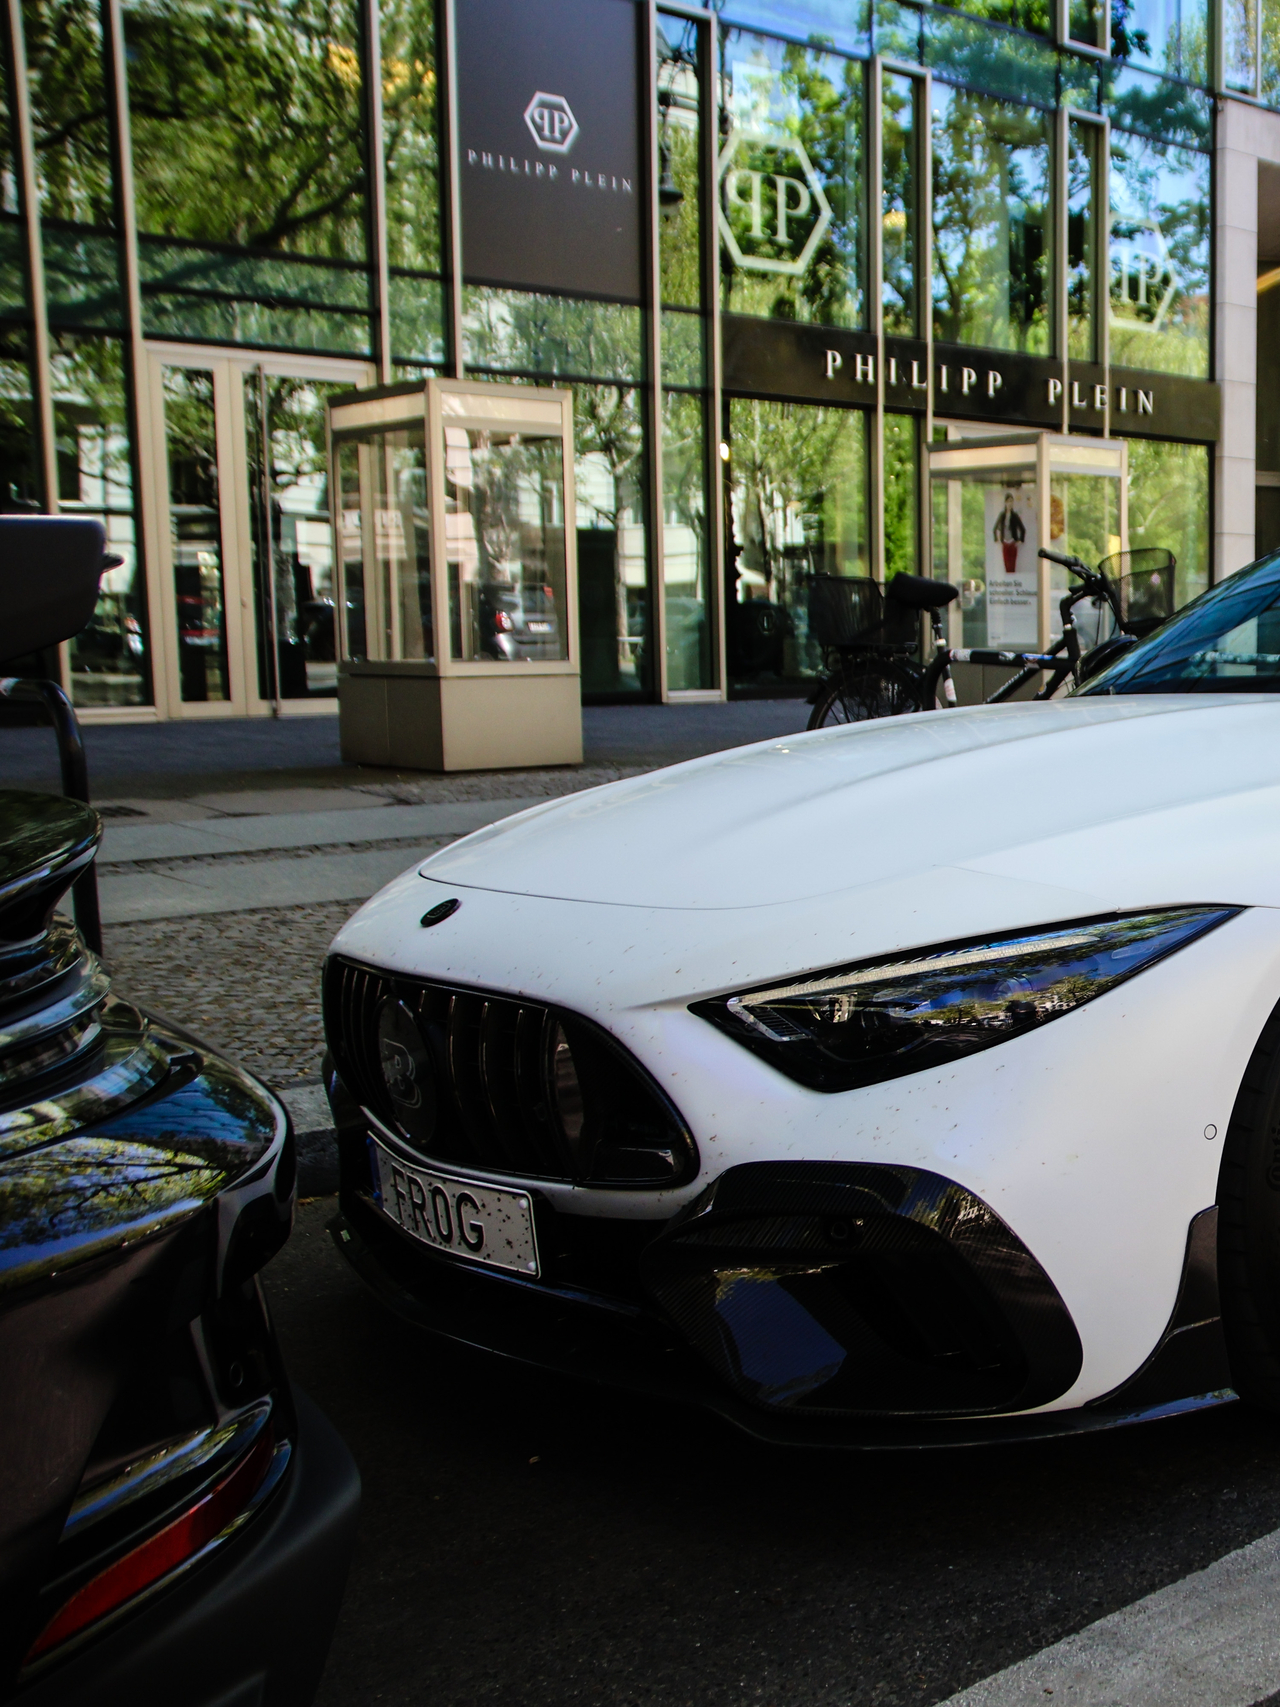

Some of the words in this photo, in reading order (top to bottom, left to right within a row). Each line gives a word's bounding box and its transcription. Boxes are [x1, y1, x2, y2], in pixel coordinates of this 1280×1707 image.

[467, 148, 559, 178] PHILIPP
[571, 168, 634, 193] PLEIN
[825, 349, 1003, 398] PHILIPP
[1047, 377, 1155, 415] PLEIN
[391, 1162, 485, 1252] FROG
